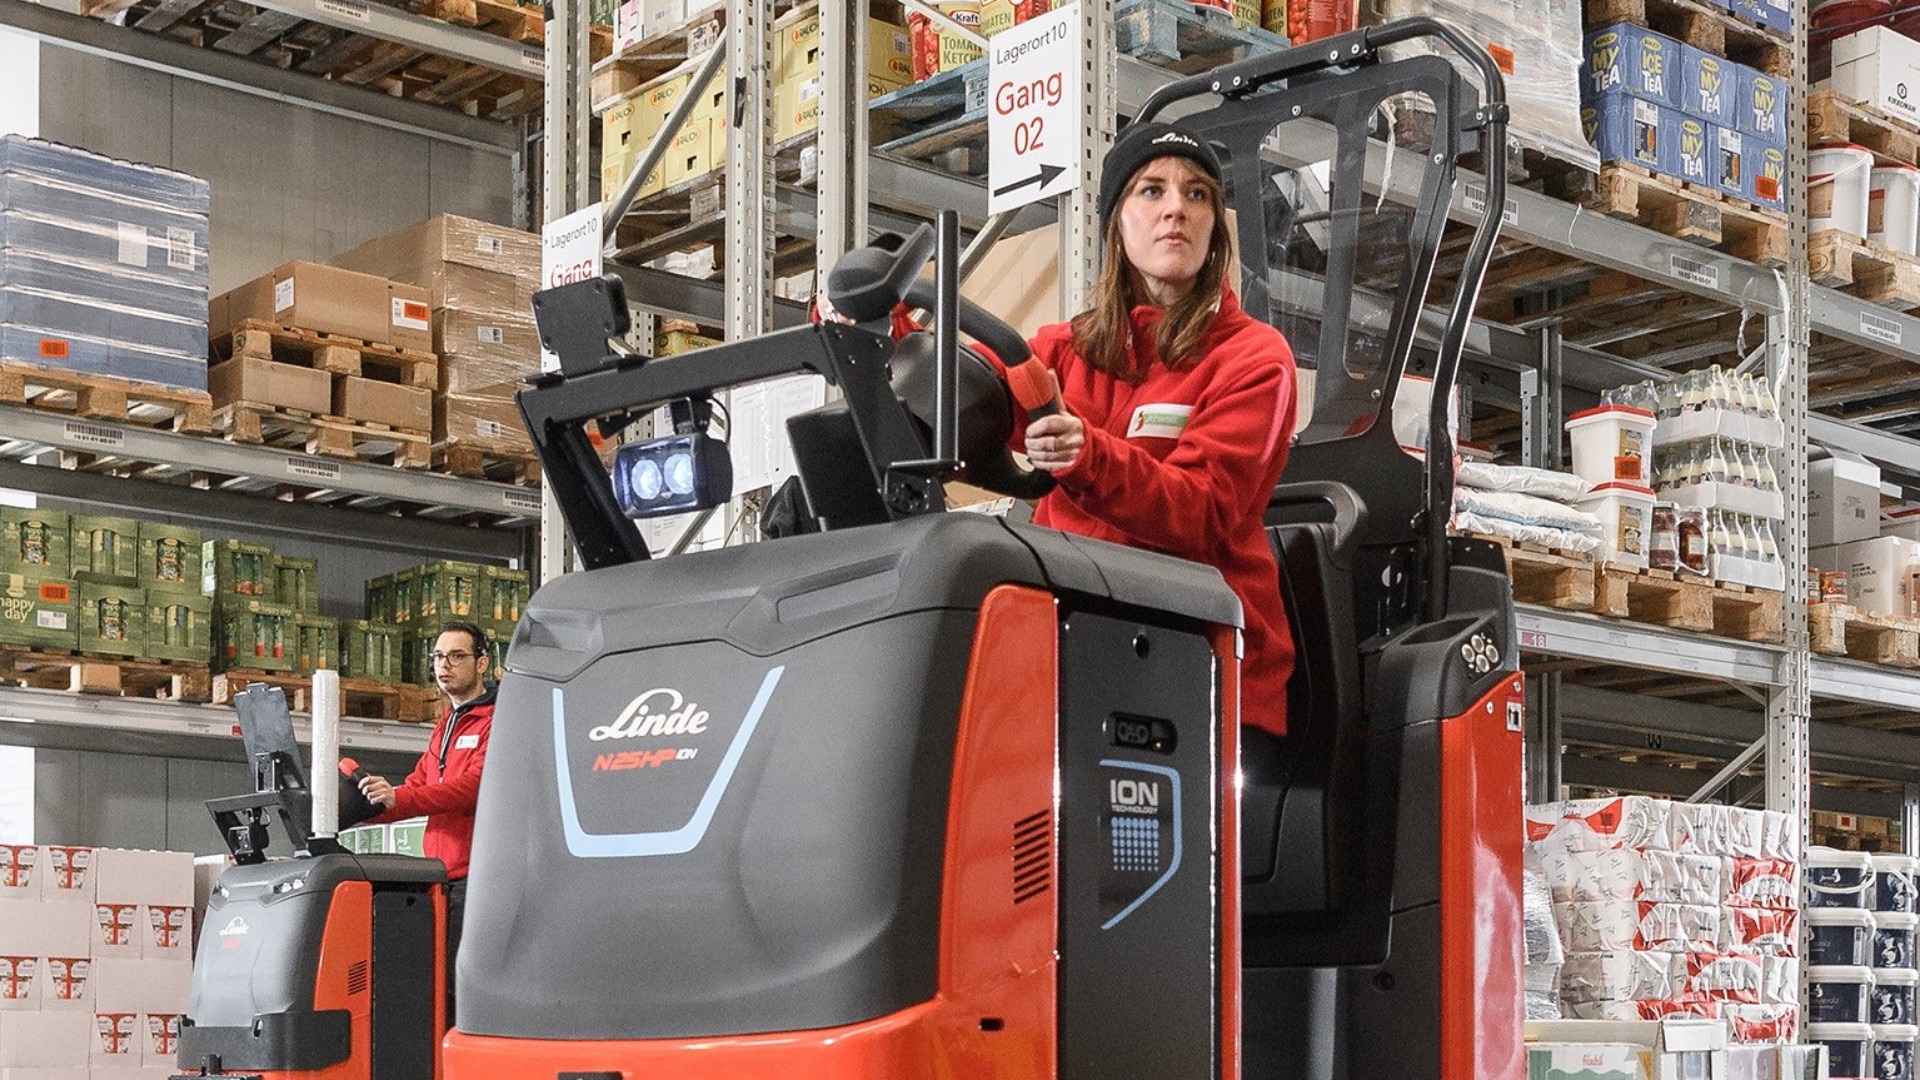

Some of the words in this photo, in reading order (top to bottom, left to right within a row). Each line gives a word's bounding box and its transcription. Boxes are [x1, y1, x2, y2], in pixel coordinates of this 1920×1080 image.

[956, 13, 979, 24] Kraft
[1592, 45, 1620, 71] MY
[1642, 49, 1662, 74] ICE
[1592, 64, 1620, 93] TEA
[1641, 69, 1663, 97] TEA
[1700, 70, 1721, 96] MY
[995, 71, 1062, 115] Gang
[1699, 88, 1720, 116] TEA
[1754, 90, 1775, 116] MY
[1753, 107, 1775, 133] TEA
[1014, 116, 1044, 155] 02
[1152, 132, 1198, 147] Linde
[1682, 133, 1703, 159] MY
[1681, 153, 1704, 178] TEA
[5, 608, 28, 623] day
[1532, 634, 1545, 648] 18
[589, 688, 709, 741] Linde
[1110, 780, 1158, 806] ION
[1112, 805, 1158, 814] TECHNOLOGY
[219, 916, 249, 936] Linde
